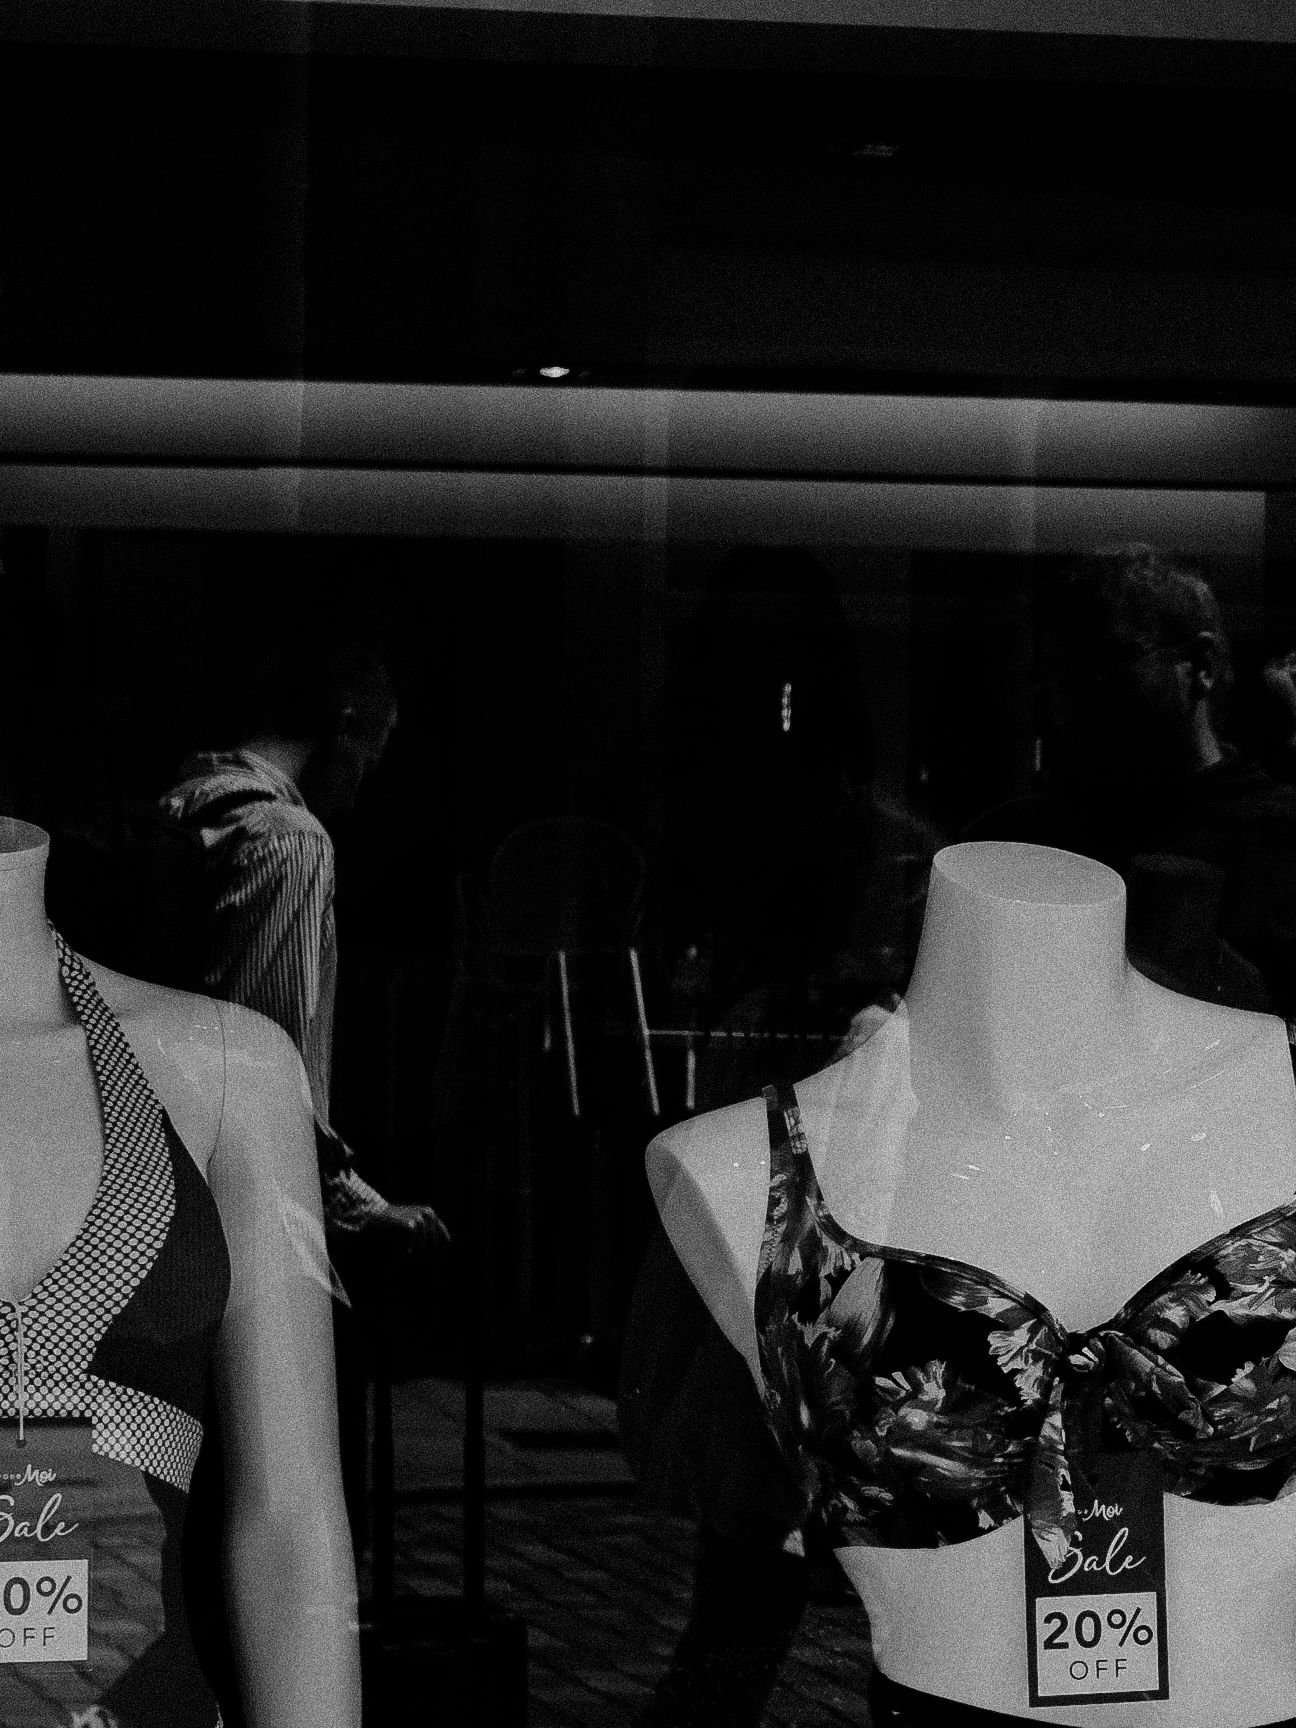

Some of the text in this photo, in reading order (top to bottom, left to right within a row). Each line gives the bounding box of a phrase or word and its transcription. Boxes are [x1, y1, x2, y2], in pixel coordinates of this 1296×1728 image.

[1048, 1527, 1146, 1584] Sale
[1043, 1607, 1154, 1651] 20%
[1069, 1658, 1127, 1680] OFF
